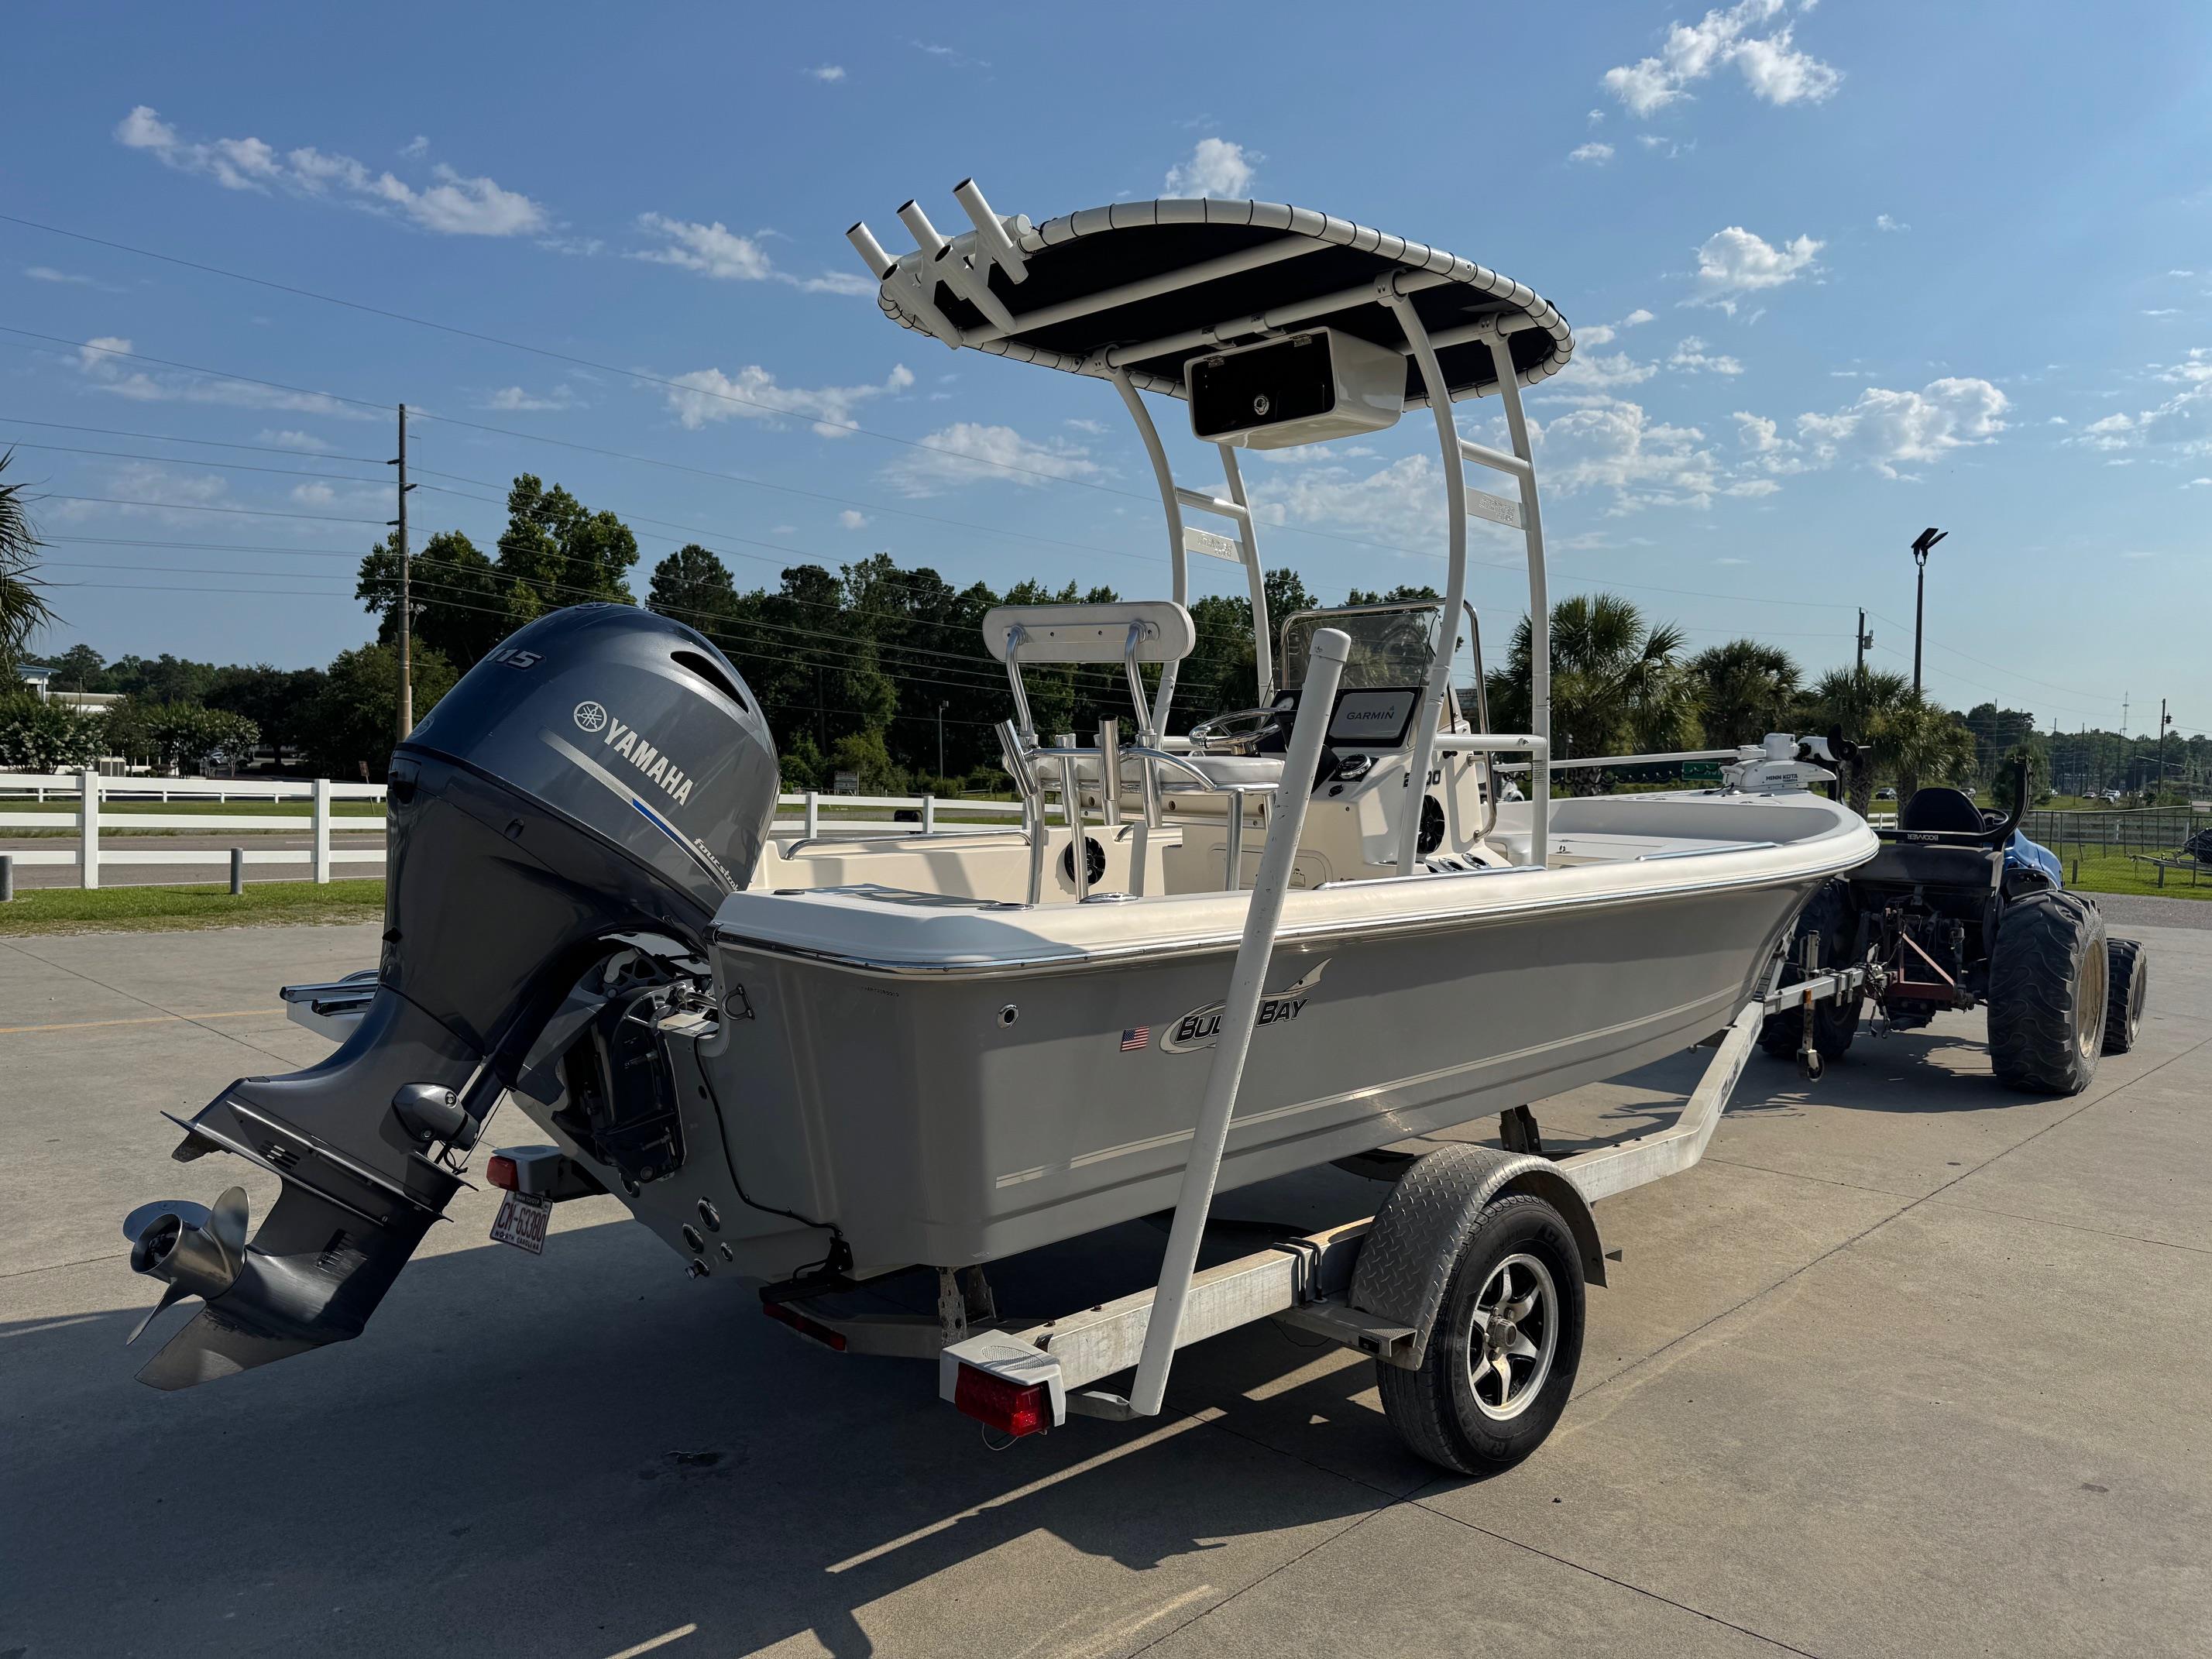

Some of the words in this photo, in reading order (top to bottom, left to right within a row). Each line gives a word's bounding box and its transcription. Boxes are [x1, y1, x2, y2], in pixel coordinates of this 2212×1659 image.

[486, 647, 544, 668] 115
[1346, 711, 1394, 720] GARMIN
[604, 717, 693, 806] YAMAHA
[694, 838, 739, 891] fourstrok
[1174, 1015, 1223, 1044] BUL
[1255, 998, 1310, 1028] BAY
[496, 1231, 514, 1241] NORTH
[517, 1238, 540, 1250] CAROLINA
